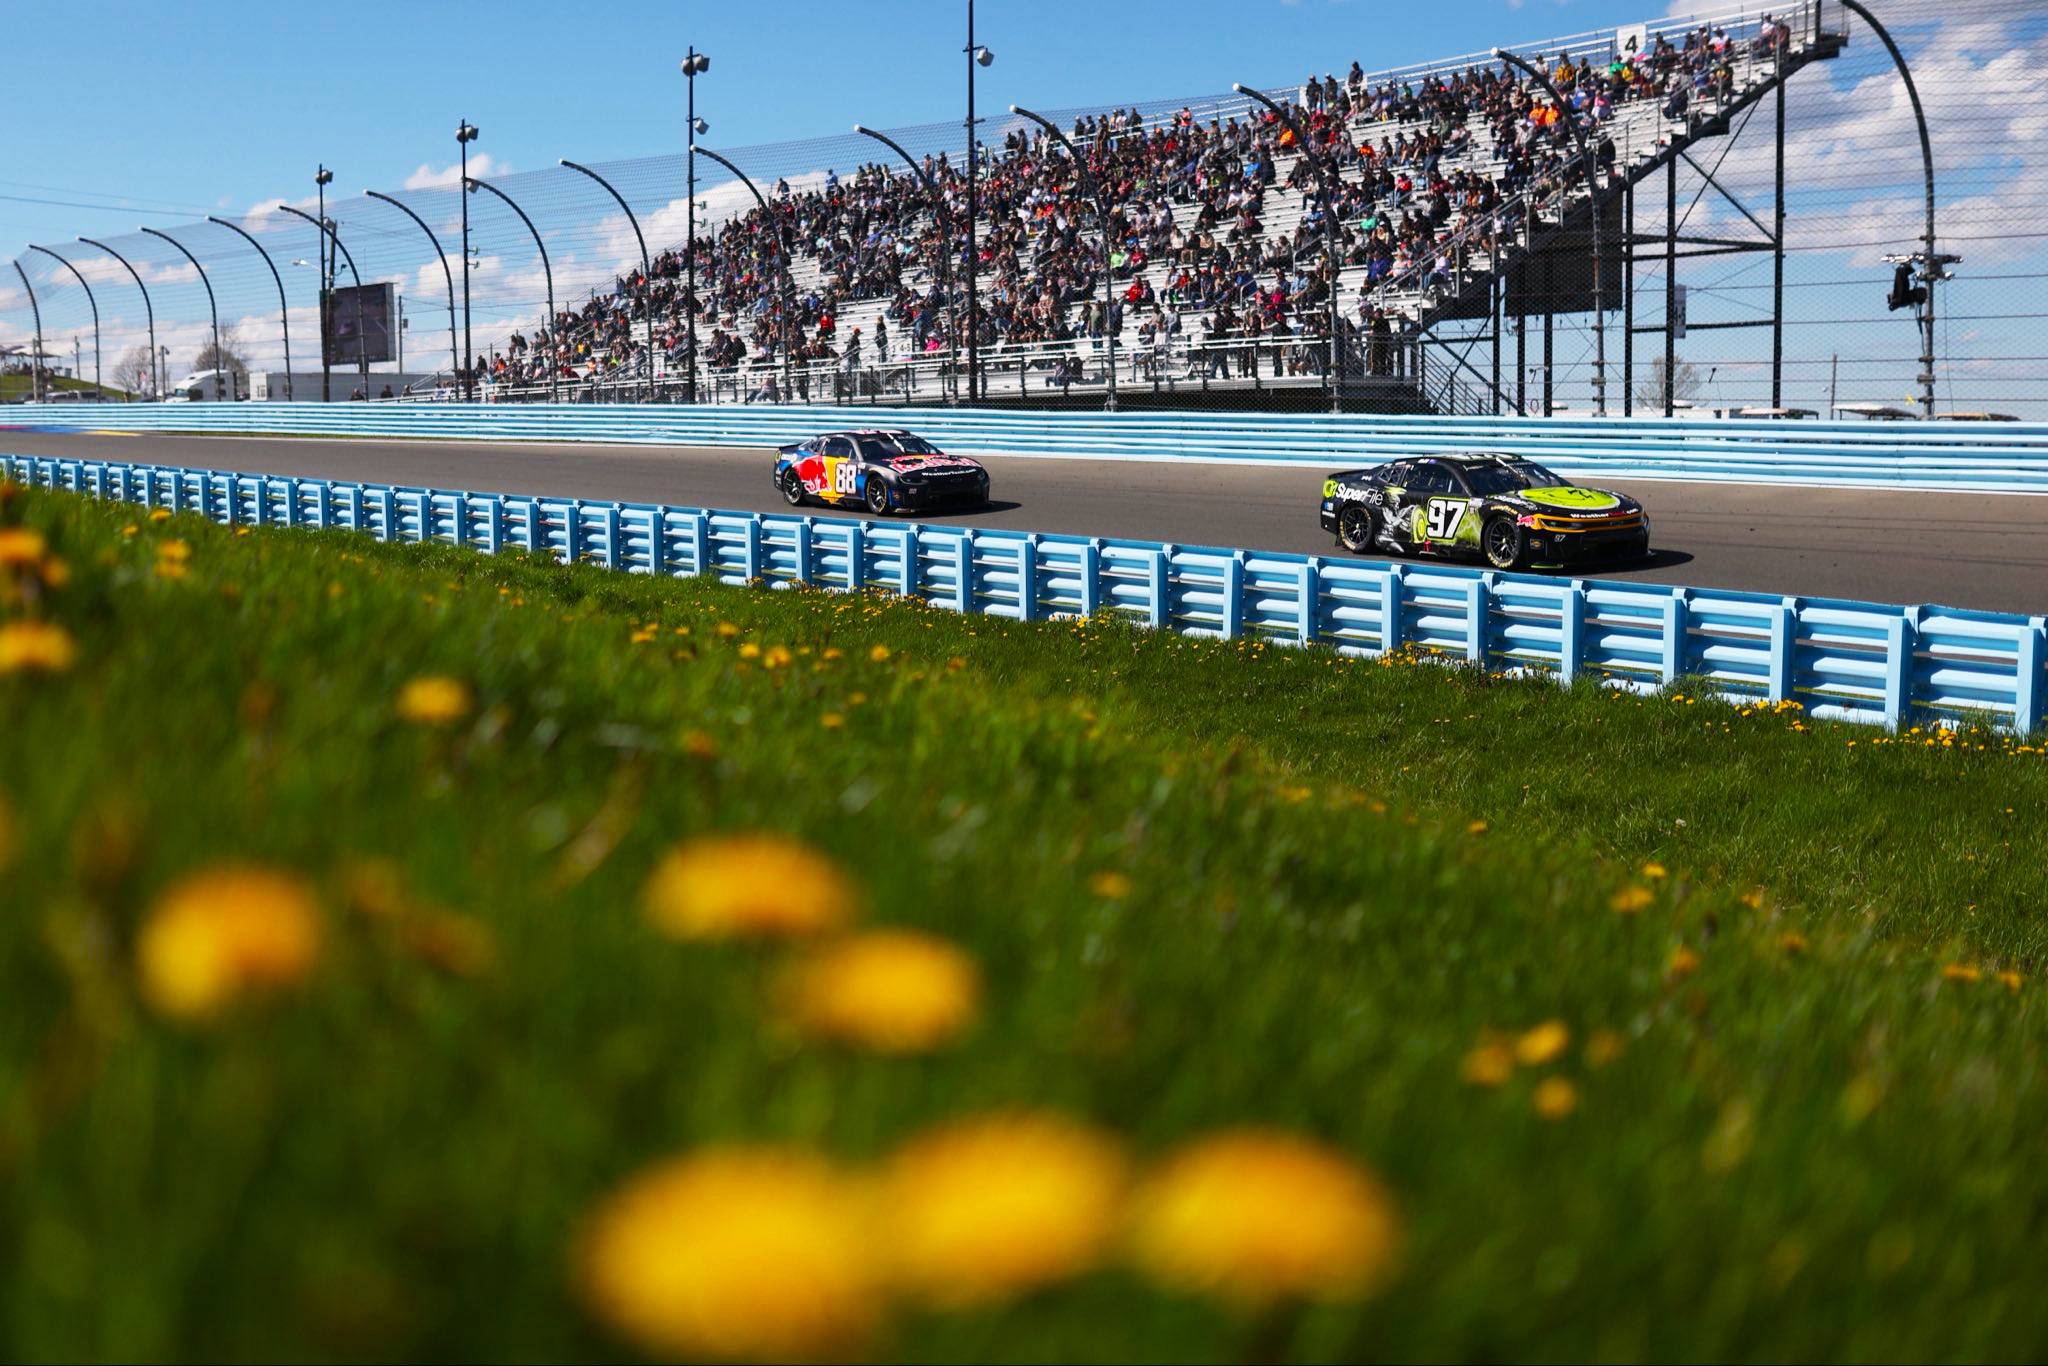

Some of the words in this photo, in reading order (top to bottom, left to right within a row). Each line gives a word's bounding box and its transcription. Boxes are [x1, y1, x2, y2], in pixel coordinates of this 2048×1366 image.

[1625, 35, 1638, 53] 4
[836, 463, 857, 494] 88
[1427, 499, 1468, 538] 97
